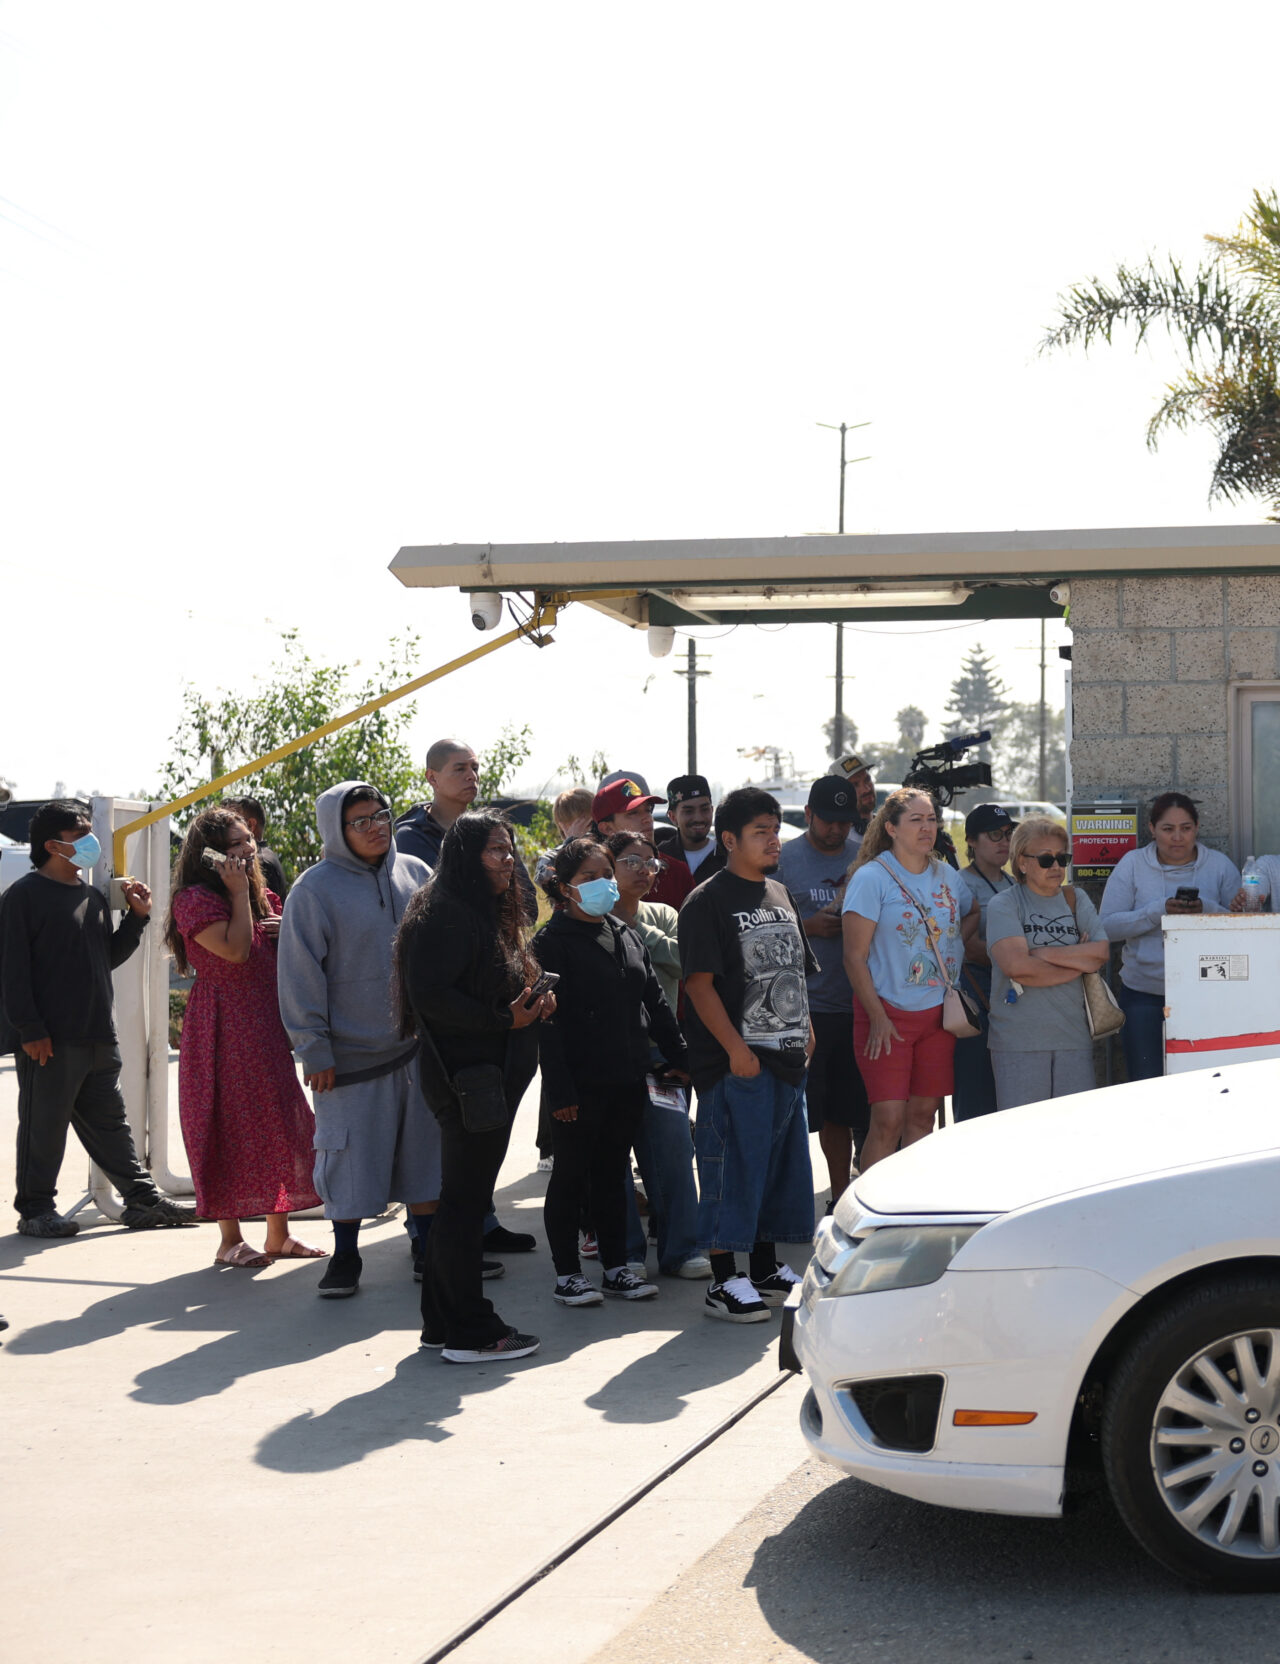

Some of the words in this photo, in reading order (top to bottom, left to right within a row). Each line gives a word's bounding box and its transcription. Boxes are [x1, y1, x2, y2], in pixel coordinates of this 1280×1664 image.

[1076, 819, 1133, 831] WARNING!
[1077, 868, 1111, 877] 800-432
[732, 908, 777, 930] Rollin
